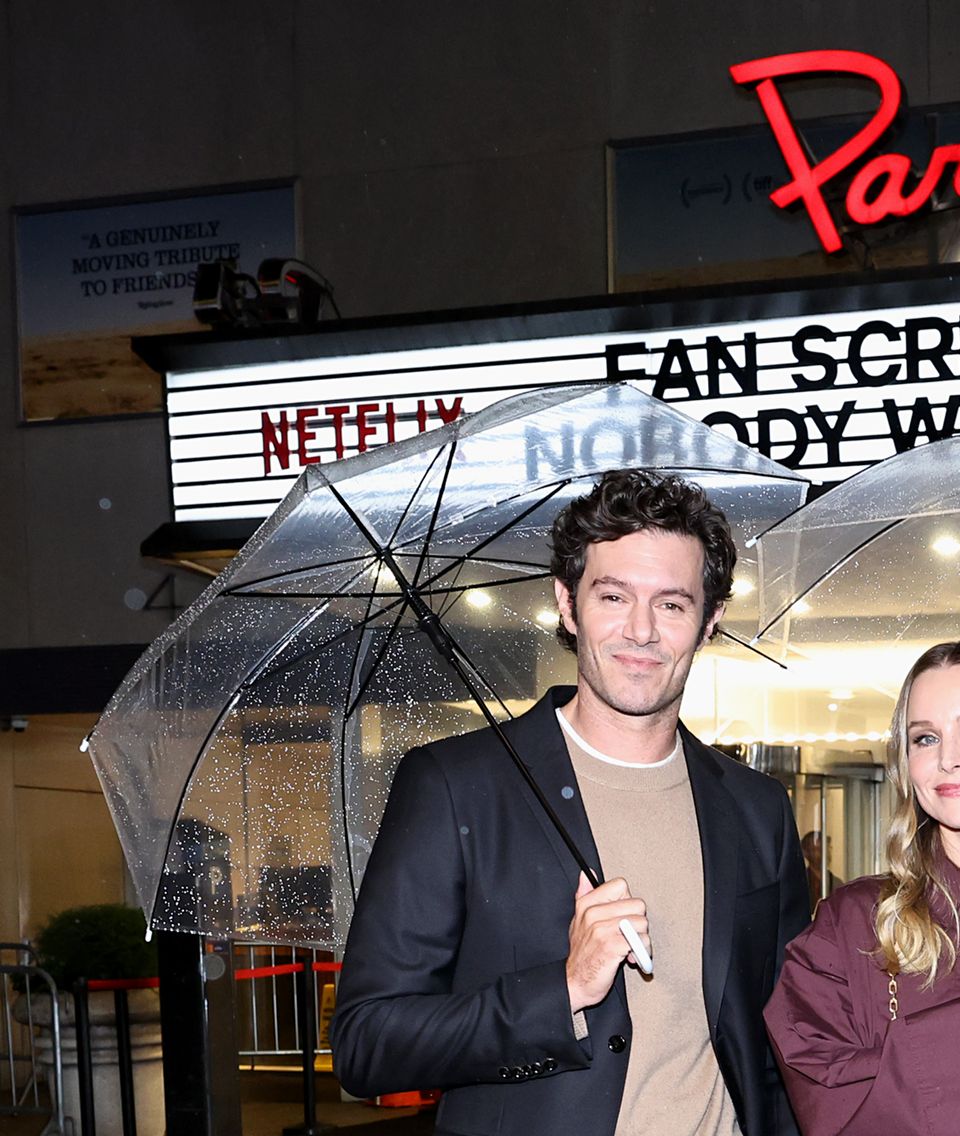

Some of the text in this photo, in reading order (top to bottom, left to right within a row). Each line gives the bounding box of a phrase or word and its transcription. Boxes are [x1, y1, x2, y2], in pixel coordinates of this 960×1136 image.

[106, 220, 221, 247] GENUINELY
[72, 243, 241, 274] MOVING TRIBUTE
[81, 271, 198, 297] TO FRIENDS
[605, 332, 759, 401] FAN
